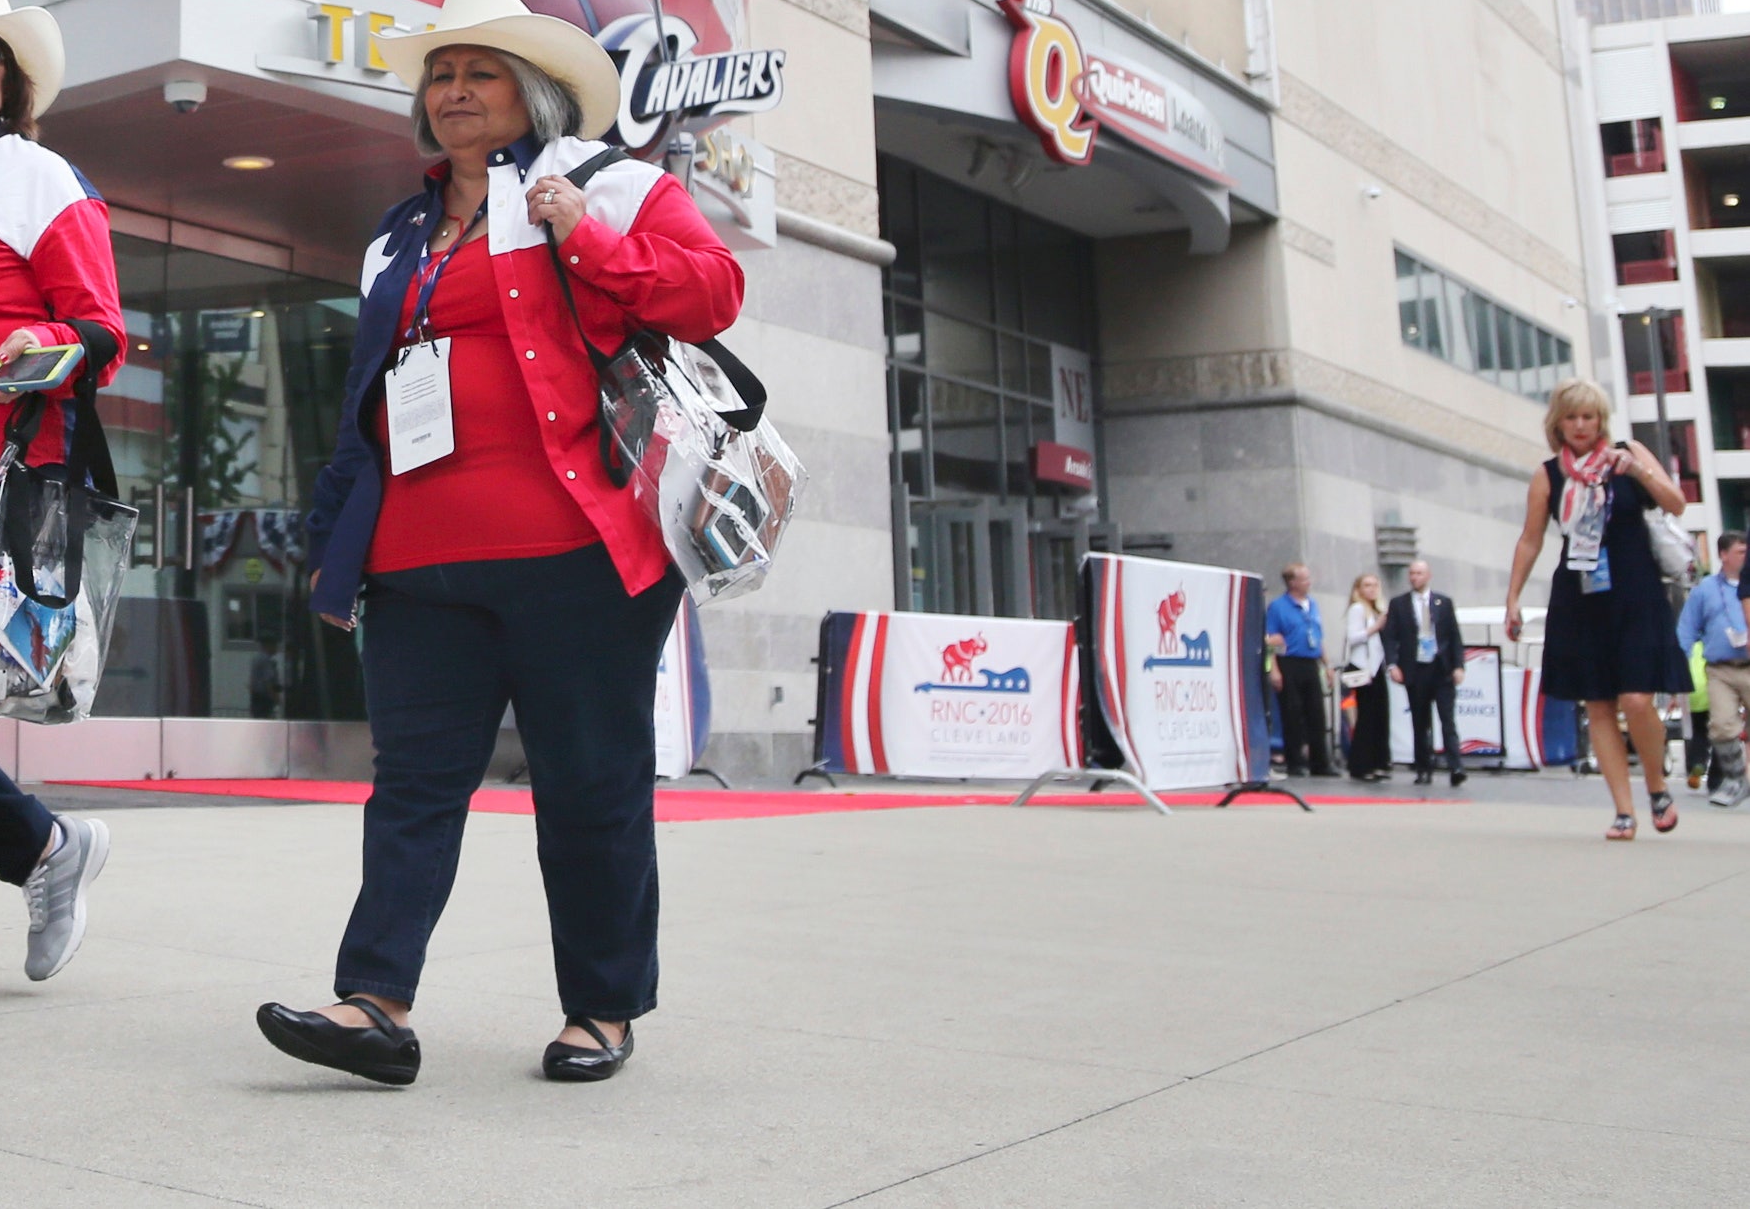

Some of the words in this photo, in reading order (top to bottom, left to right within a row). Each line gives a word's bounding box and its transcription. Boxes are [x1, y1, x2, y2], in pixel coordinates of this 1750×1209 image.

[1025, 12, 1093, 160] Q
[1089, 60, 1165, 123] Quicken
[1155, 679, 1184, 712] RNC
[1190, 679, 1218, 712] 2016
[931, 700, 977, 724] RNC
[987, 701, 1032, 726] 2016
[931, 729, 1031, 745] CLEVELAND
